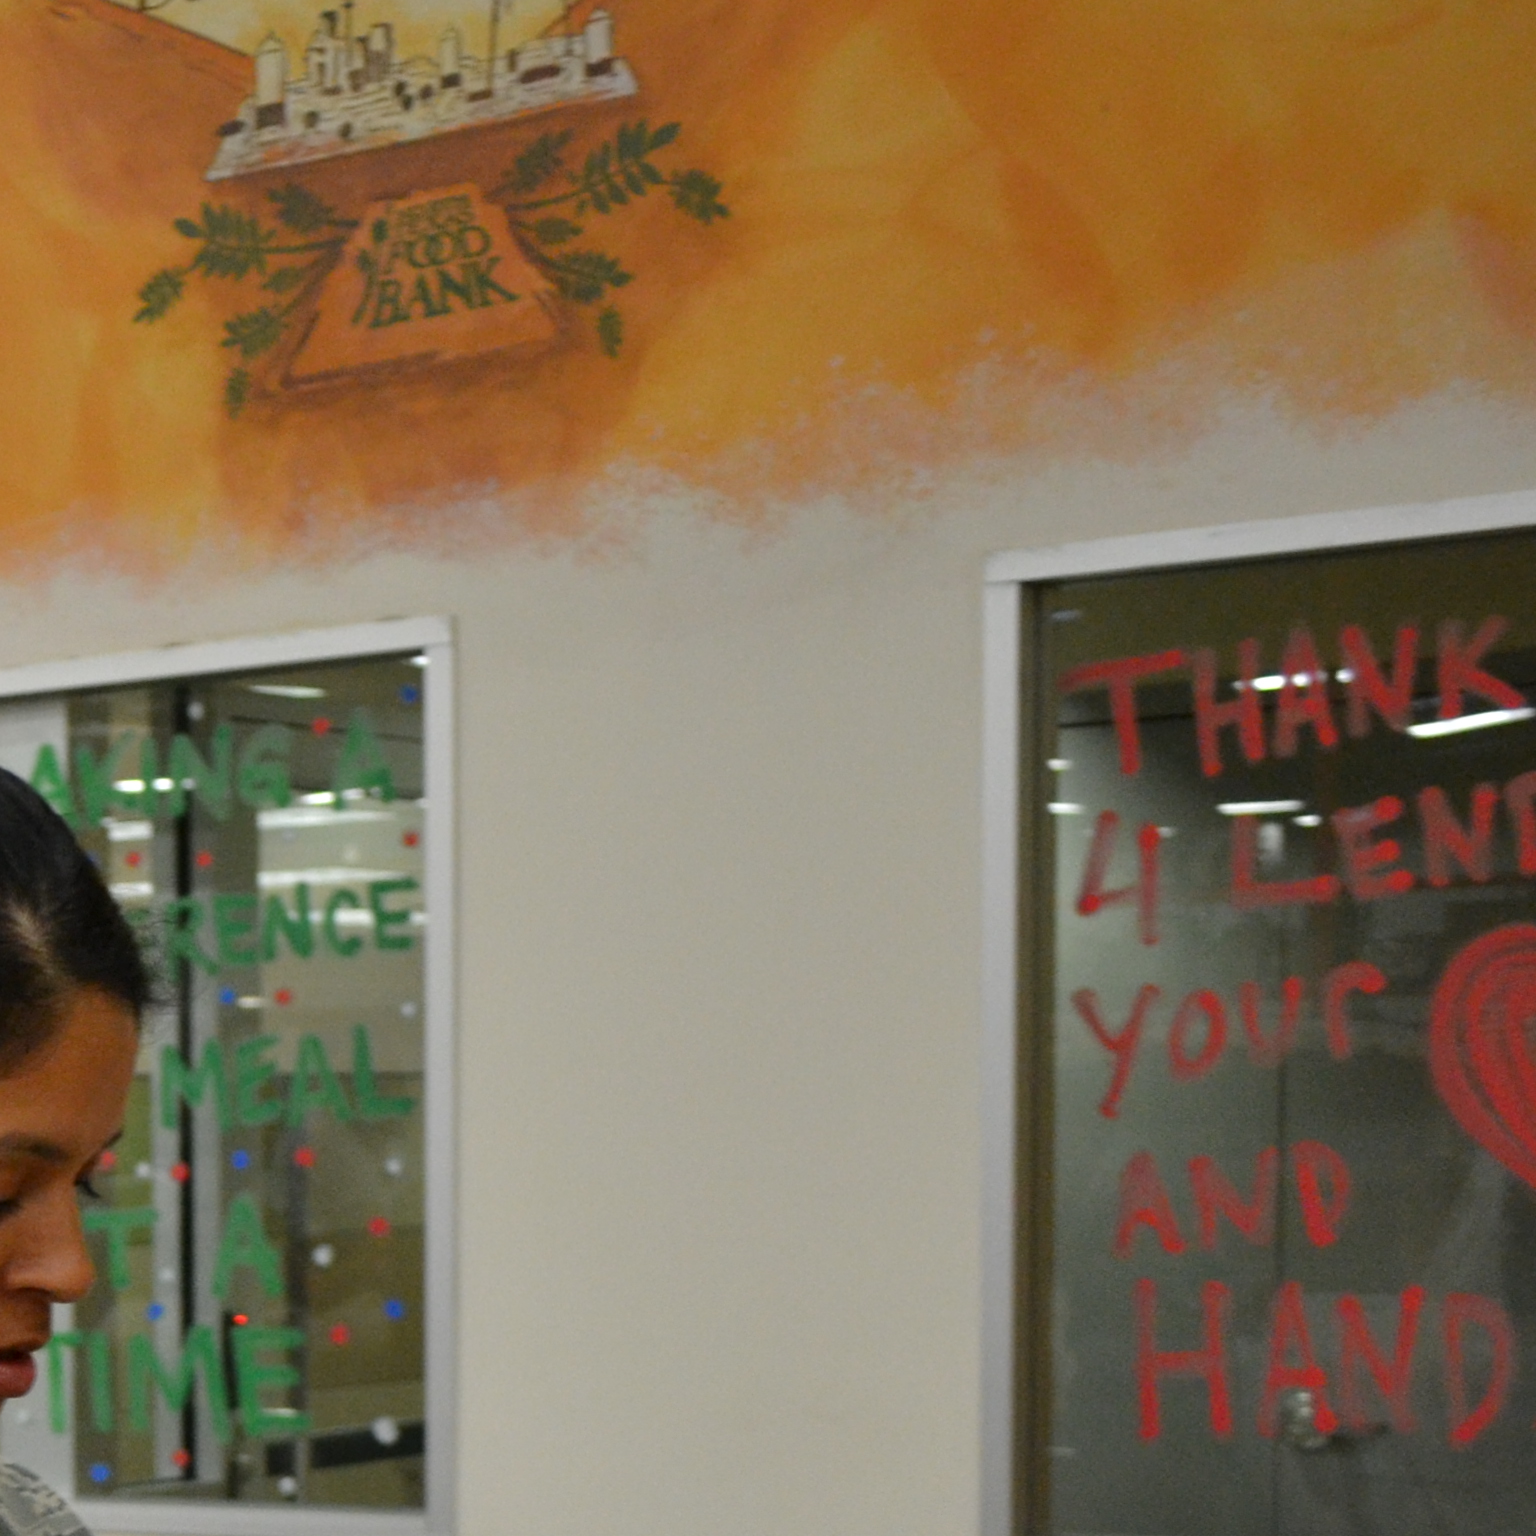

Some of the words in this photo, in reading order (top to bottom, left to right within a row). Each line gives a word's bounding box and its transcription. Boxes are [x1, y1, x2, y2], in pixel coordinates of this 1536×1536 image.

[369, 256, 522, 329] BANK
[1057, 615, 1526, 778] THANK
[331, 706, 395, 811] A
[128, 876, 419, 987] RENCE
[1075, 810, 1161, 945] 4
[159, 1024, 413, 1132] MEAL
[213, 1192, 286, 1301] A
[1114, 1140, 1352, 1257] AND
[43, 1324, 312, 1441] TIME
[1134, 1274, 1519, 1449] HAND
